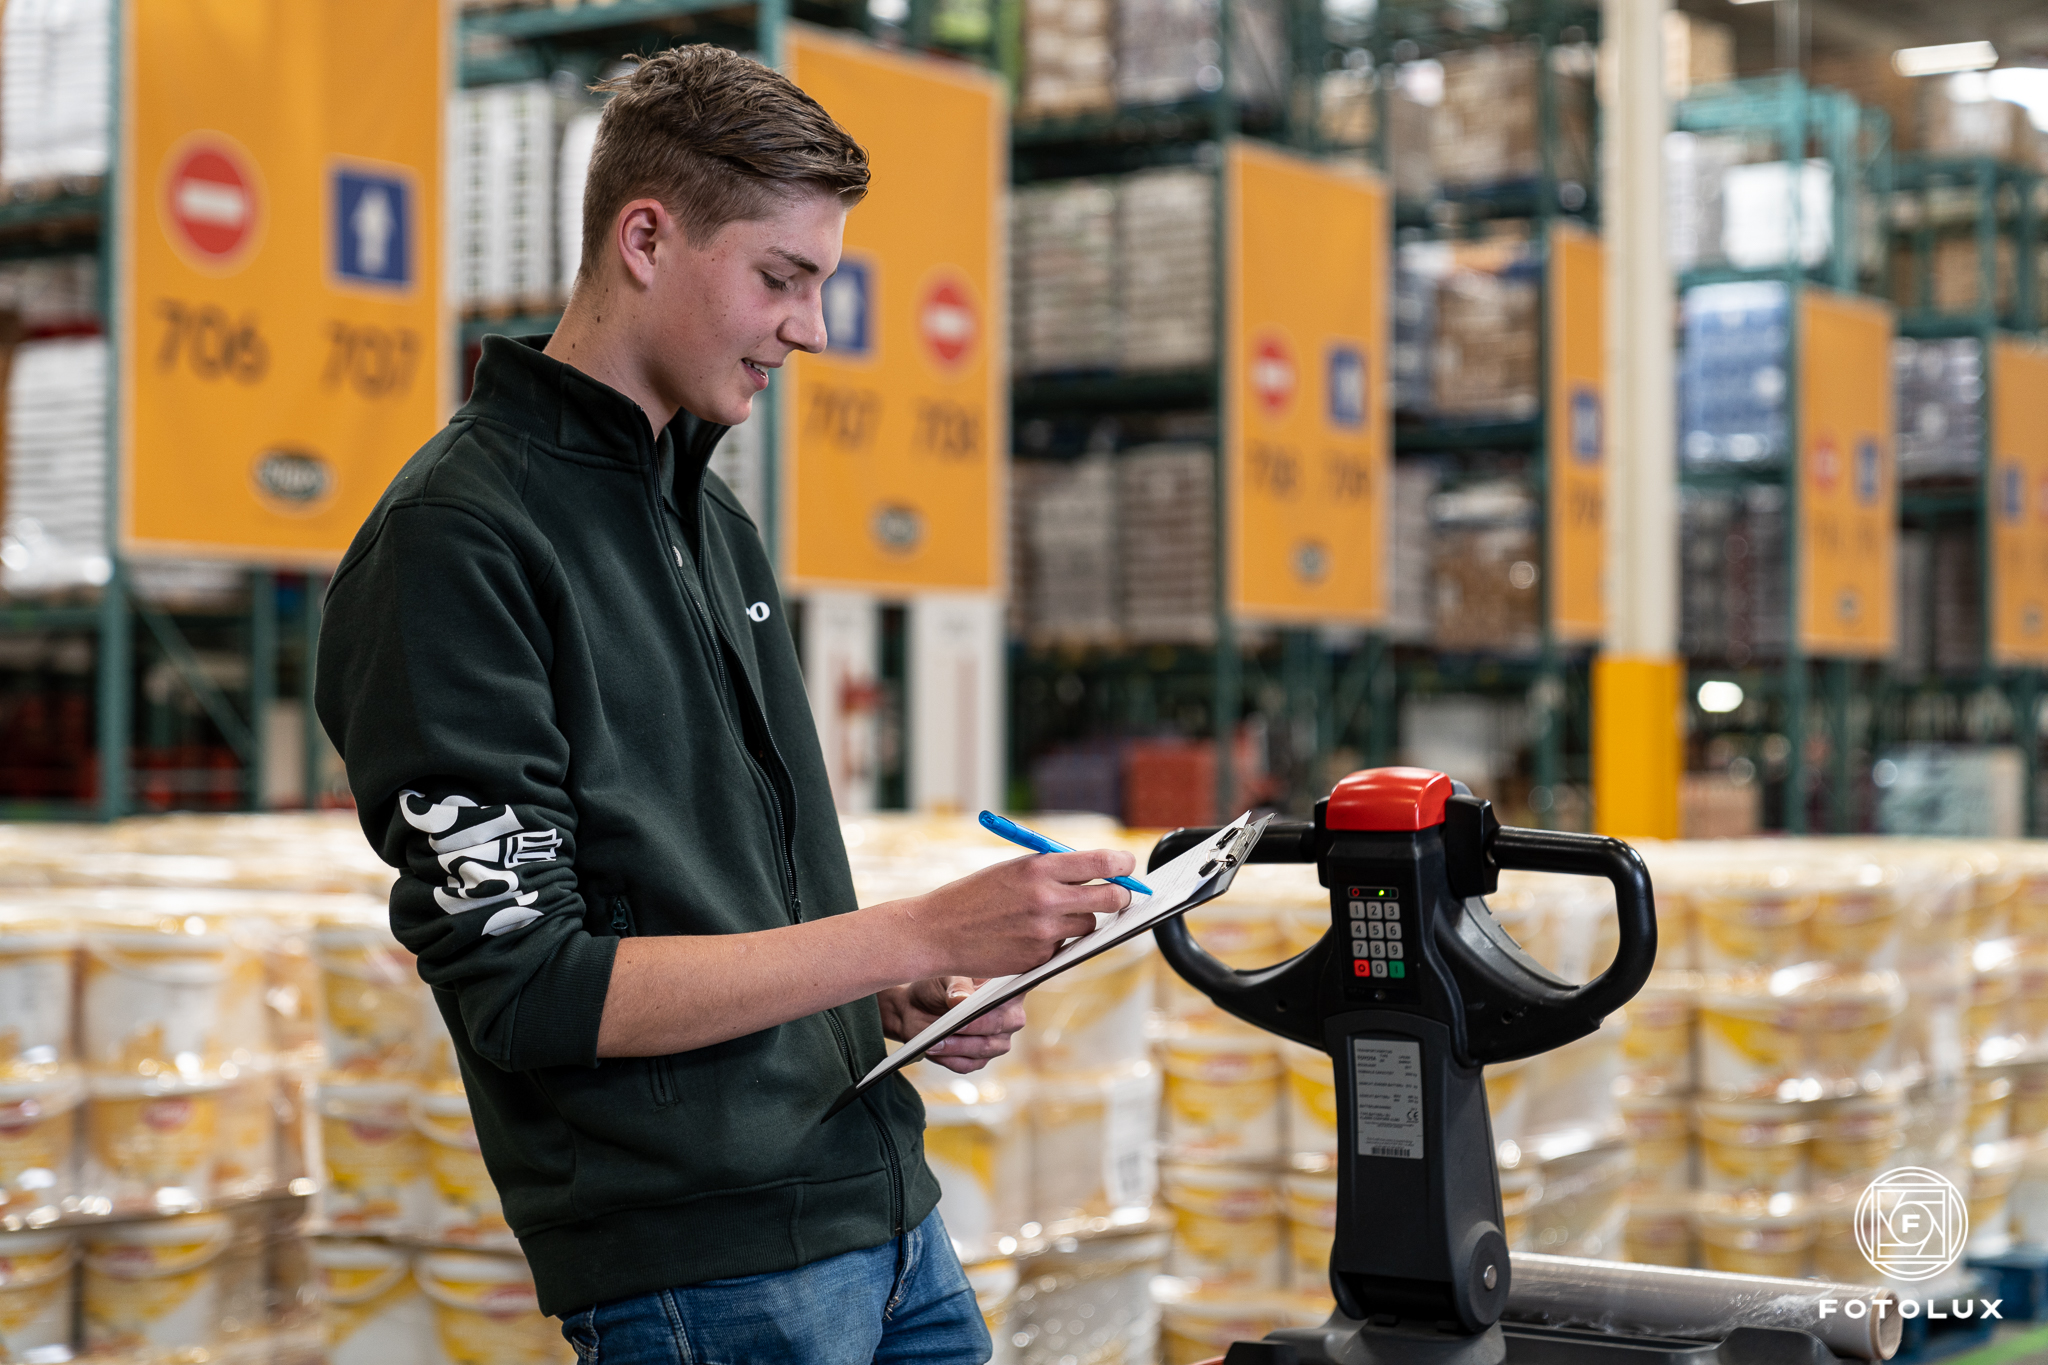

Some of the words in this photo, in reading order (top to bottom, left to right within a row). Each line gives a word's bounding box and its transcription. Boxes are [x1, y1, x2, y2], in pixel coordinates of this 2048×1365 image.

[154, 298, 270, 387] 706
[1370, 905, 1378, 916] 2
[1388, 906, 1396, 917] 3
[1355, 925, 1362, 935] 4
[1372, 925, 1379, 936] 5
[1389, 925, 1397, 936] 6
[1356, 943, 1364, 954] 7
[1374, 944, 1381, 955] 8
[1391, 945, 1398, 956] 9
